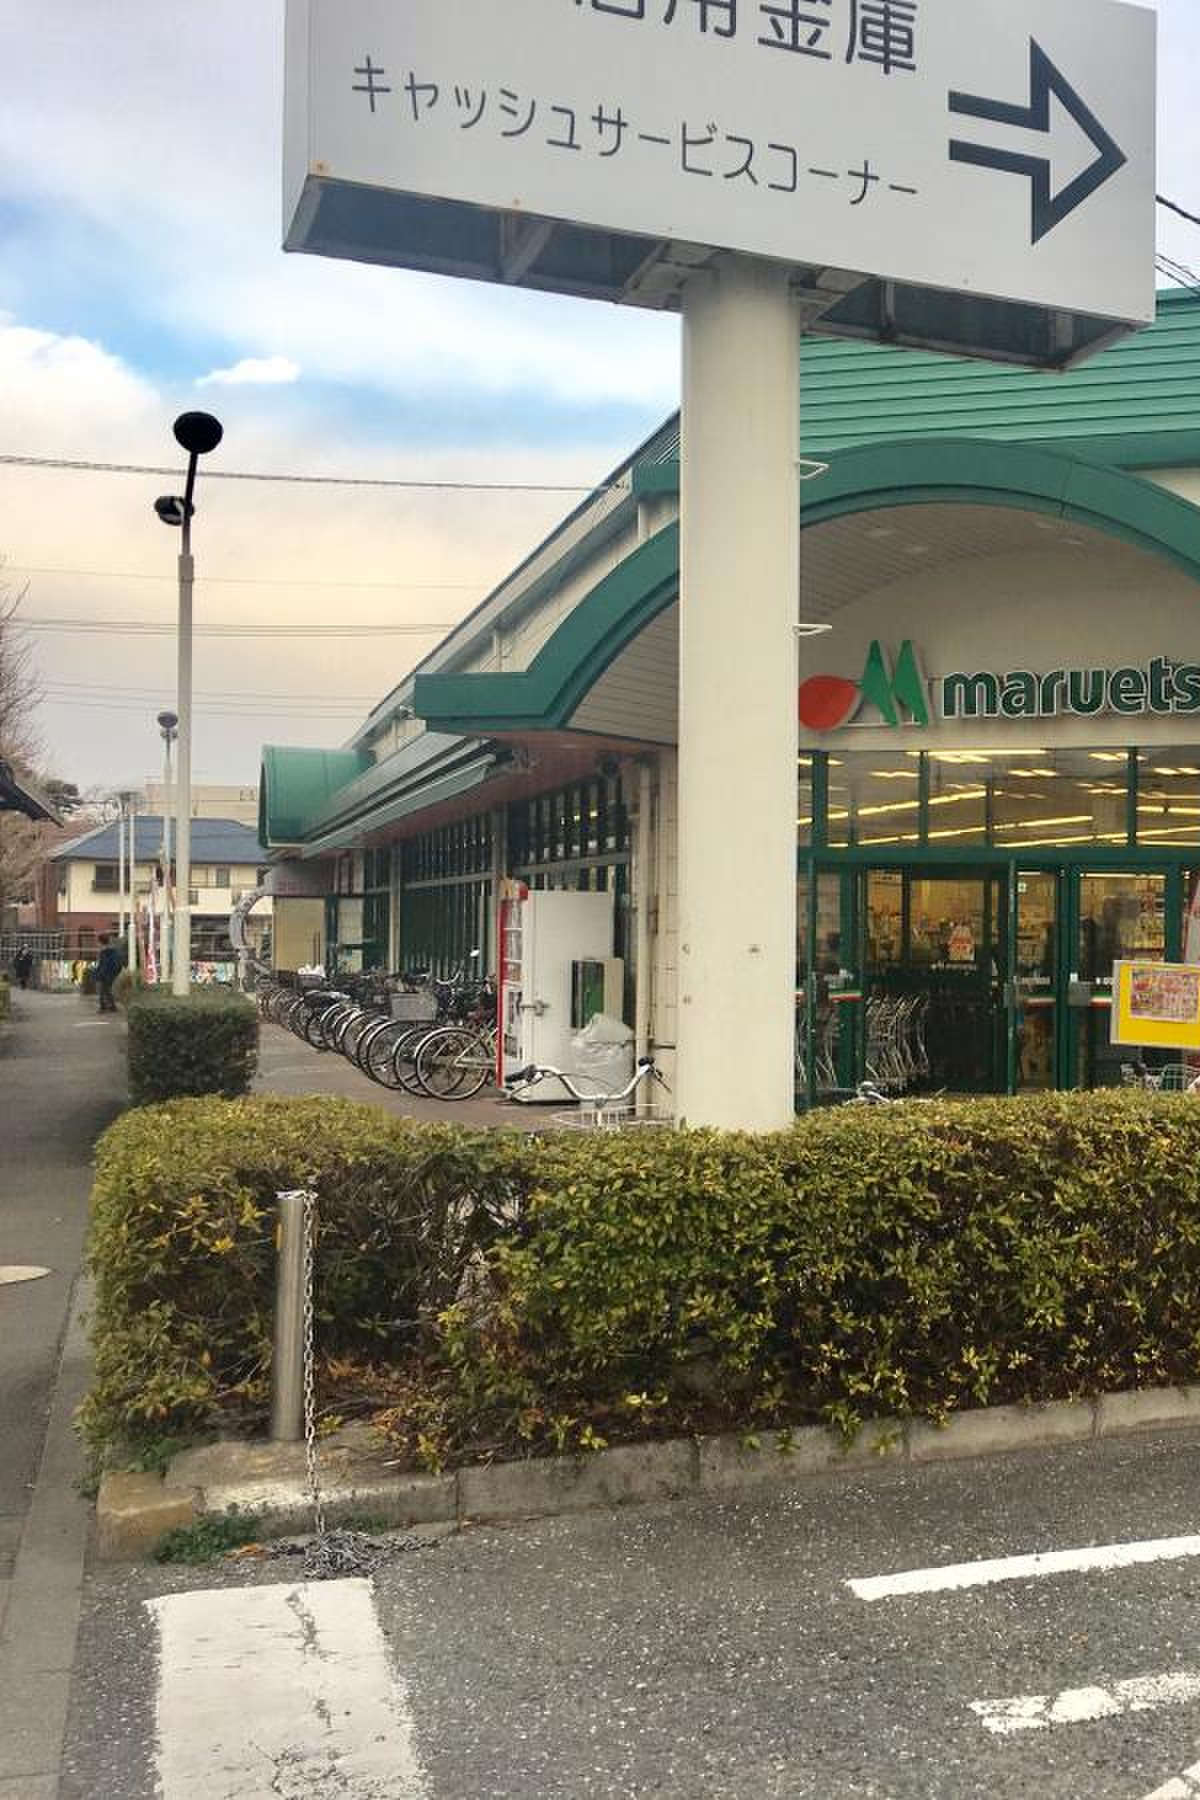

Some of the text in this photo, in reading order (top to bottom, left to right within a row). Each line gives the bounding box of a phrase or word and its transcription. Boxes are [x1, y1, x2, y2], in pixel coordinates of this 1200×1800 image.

[351, 56, 918, 206] キャッシュサービスコーナー
